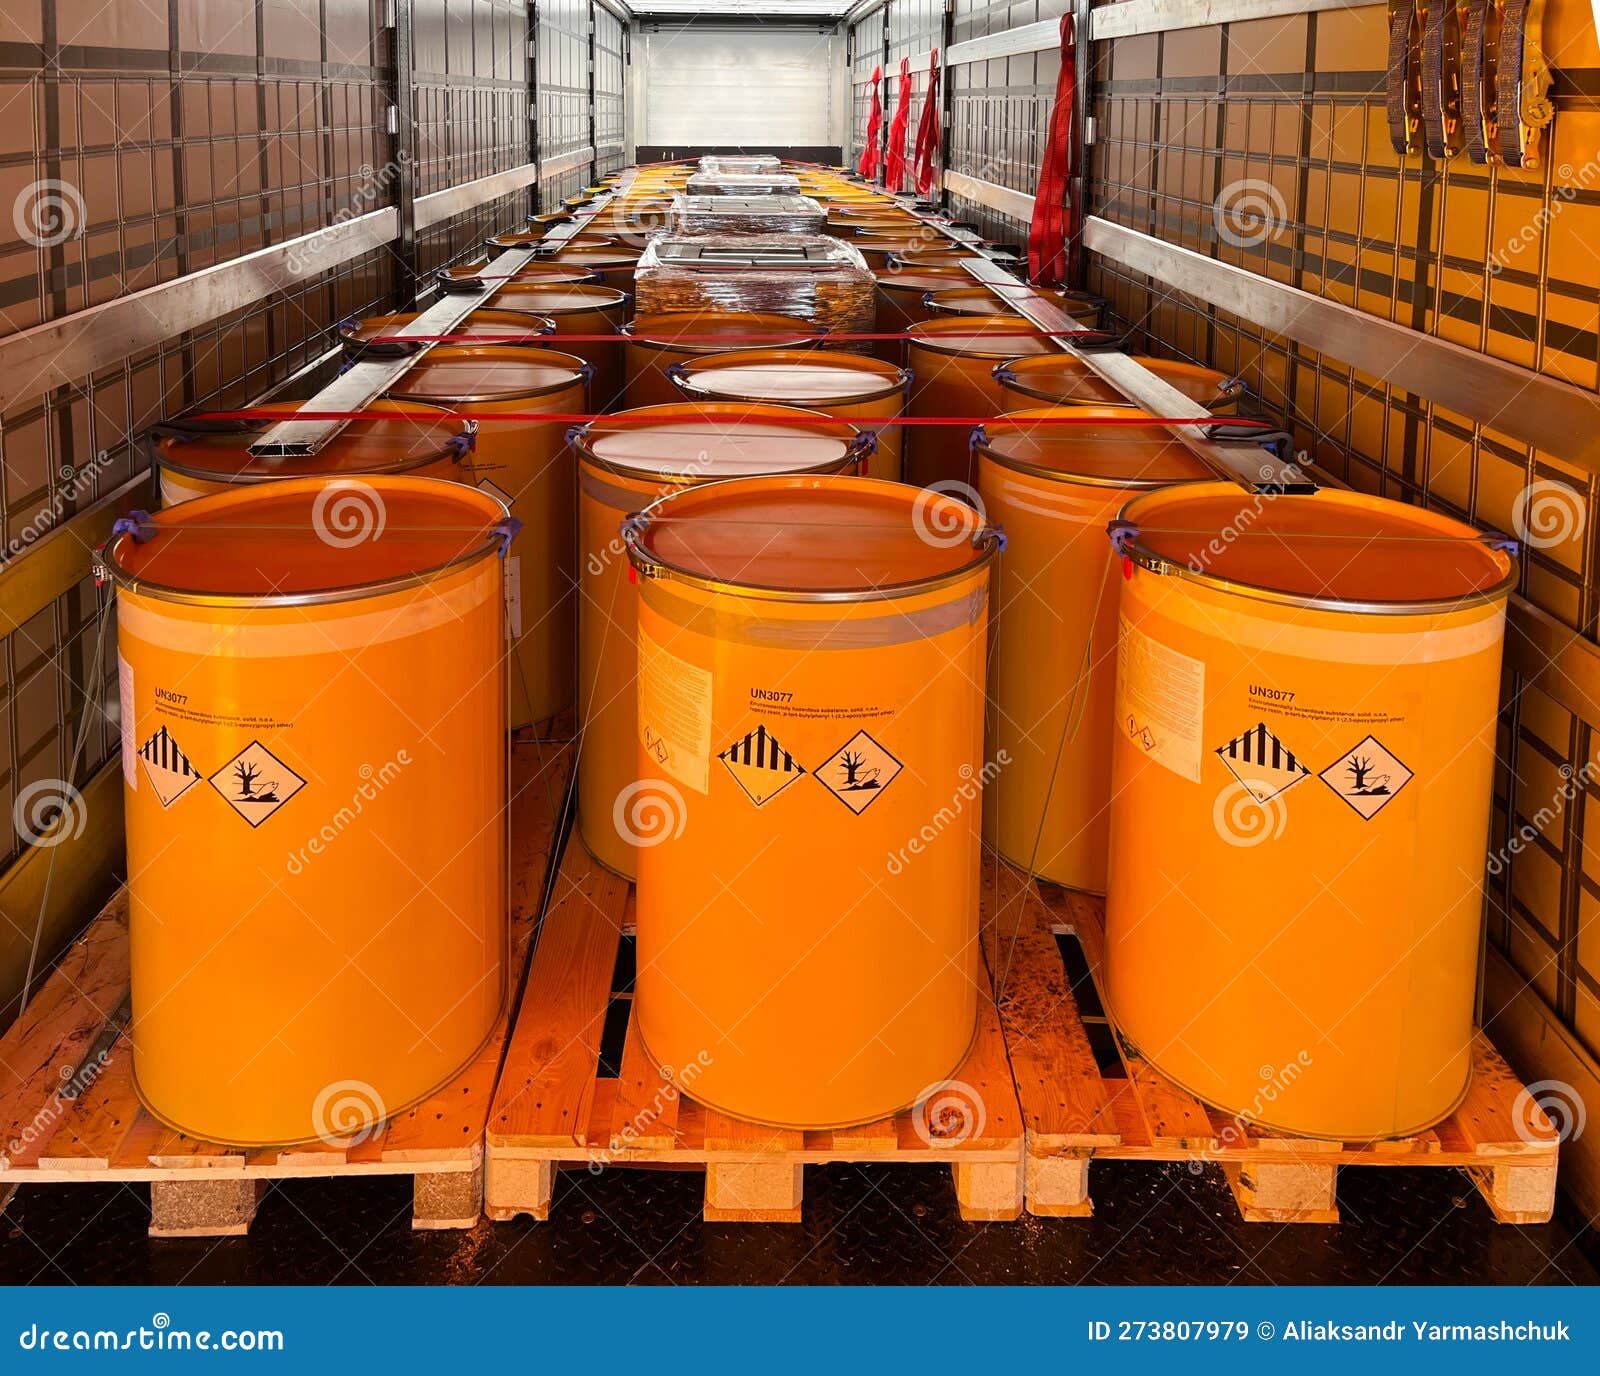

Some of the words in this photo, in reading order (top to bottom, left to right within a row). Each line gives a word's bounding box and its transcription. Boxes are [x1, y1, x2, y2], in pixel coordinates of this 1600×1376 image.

[154, 687, 188, 705] UN3077
[750, 687, 793, 702] UN3077
[1249, 684, 1295, 702] UN3077
